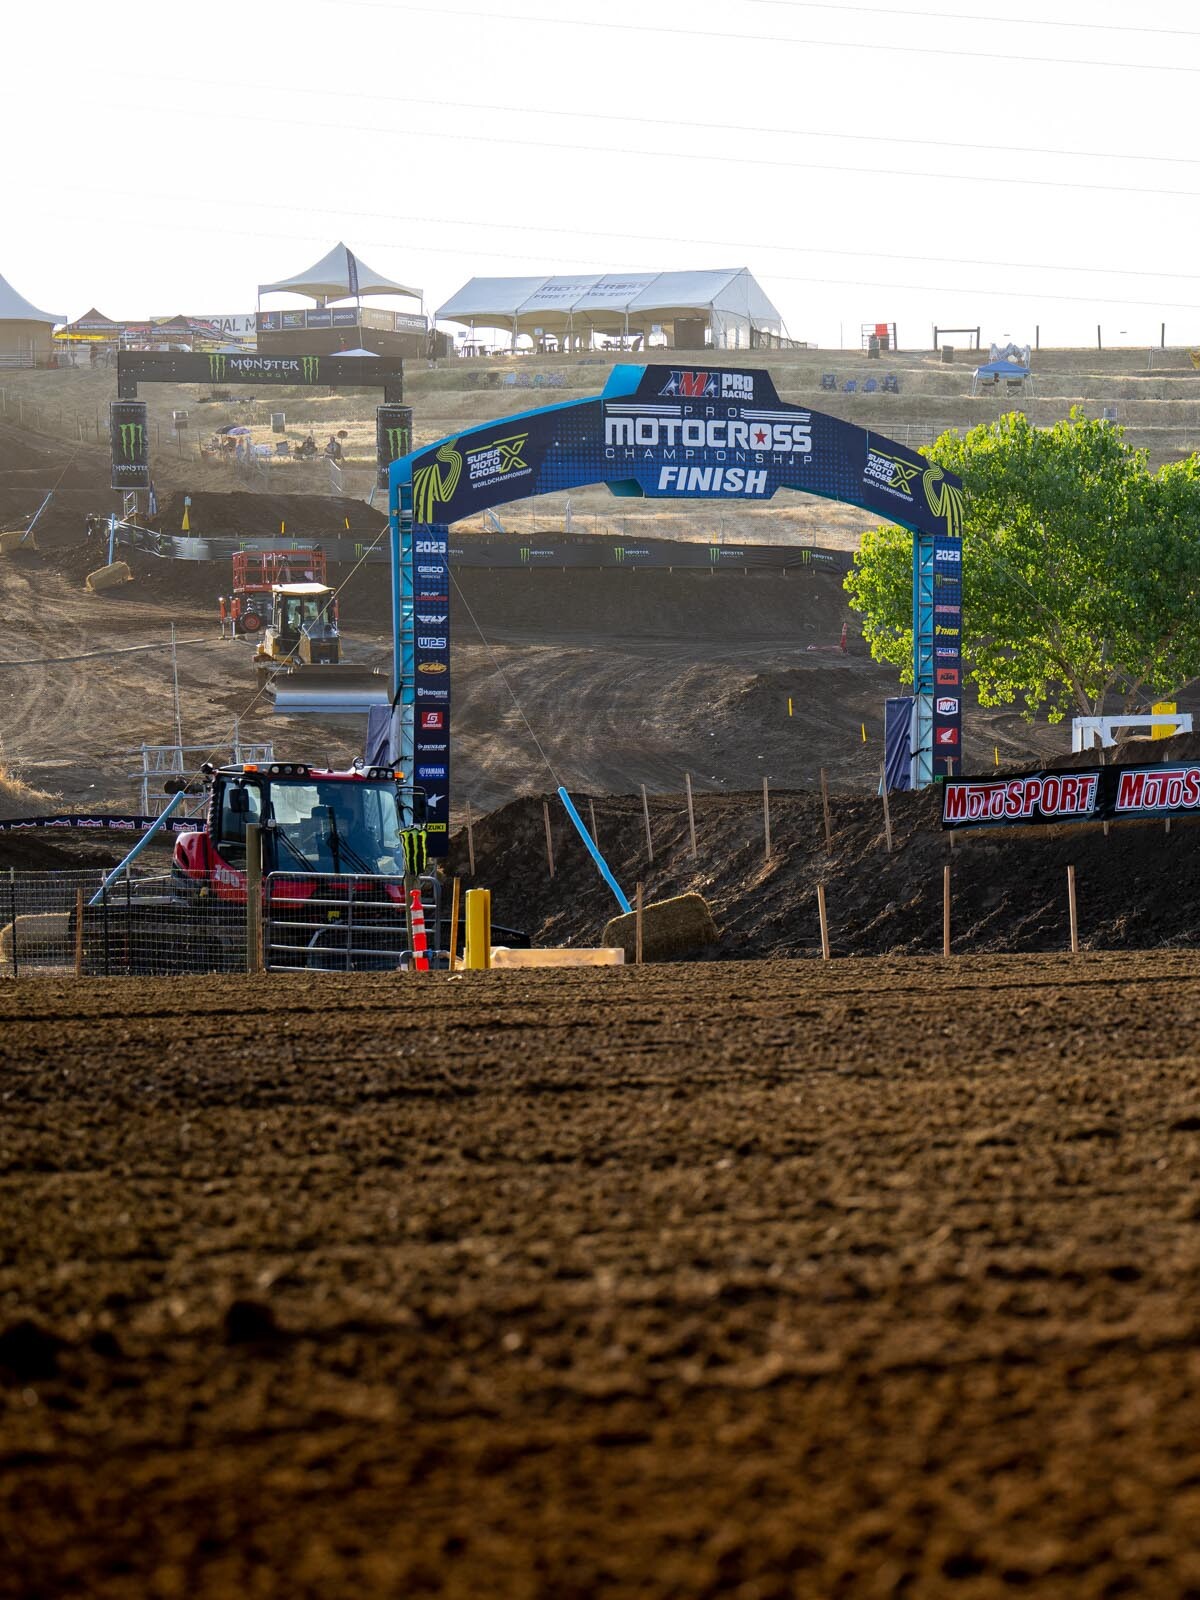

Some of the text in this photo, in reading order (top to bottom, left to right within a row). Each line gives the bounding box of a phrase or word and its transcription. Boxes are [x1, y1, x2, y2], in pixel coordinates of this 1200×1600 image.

[230, 358, 299, 370] MONSTER
[658, 371, 753, 398] AMA PRO
[722, 390, 753, 400] RACING
[684, 406, 737, 418] PRO
[605, 417, 812, 452] MOTOCROSS
[467, 449, 500, 464] SUPER
[605, 448, 813, 465] CHAMPIONSHIP
[867, 453, 897, 470] SUPER
[470, 457, 500, 471] MOTO
[867, 461, 894, 476] MOTO
[469, 464, 502, 479] CROSS
[472, 468, 533, 489] WORLD CHAMPIONSHIP
[863, 468, 892, 483] CROSS
[658, 466, 768, 494] FINISH
[862, 477, 914, 502] WORLD CHAMPIONSHIP
[415, 541, 446, 553] 2023
[936, 549, 960, 561] 2023
[417, 565, 444, 573] GEICO
[941, 628, 959, 636] THOR
[417, 637, 447, 649] WPS
[939, 701, 956, 711] 100%
[425, 767, 445, 775] YAMAHA
